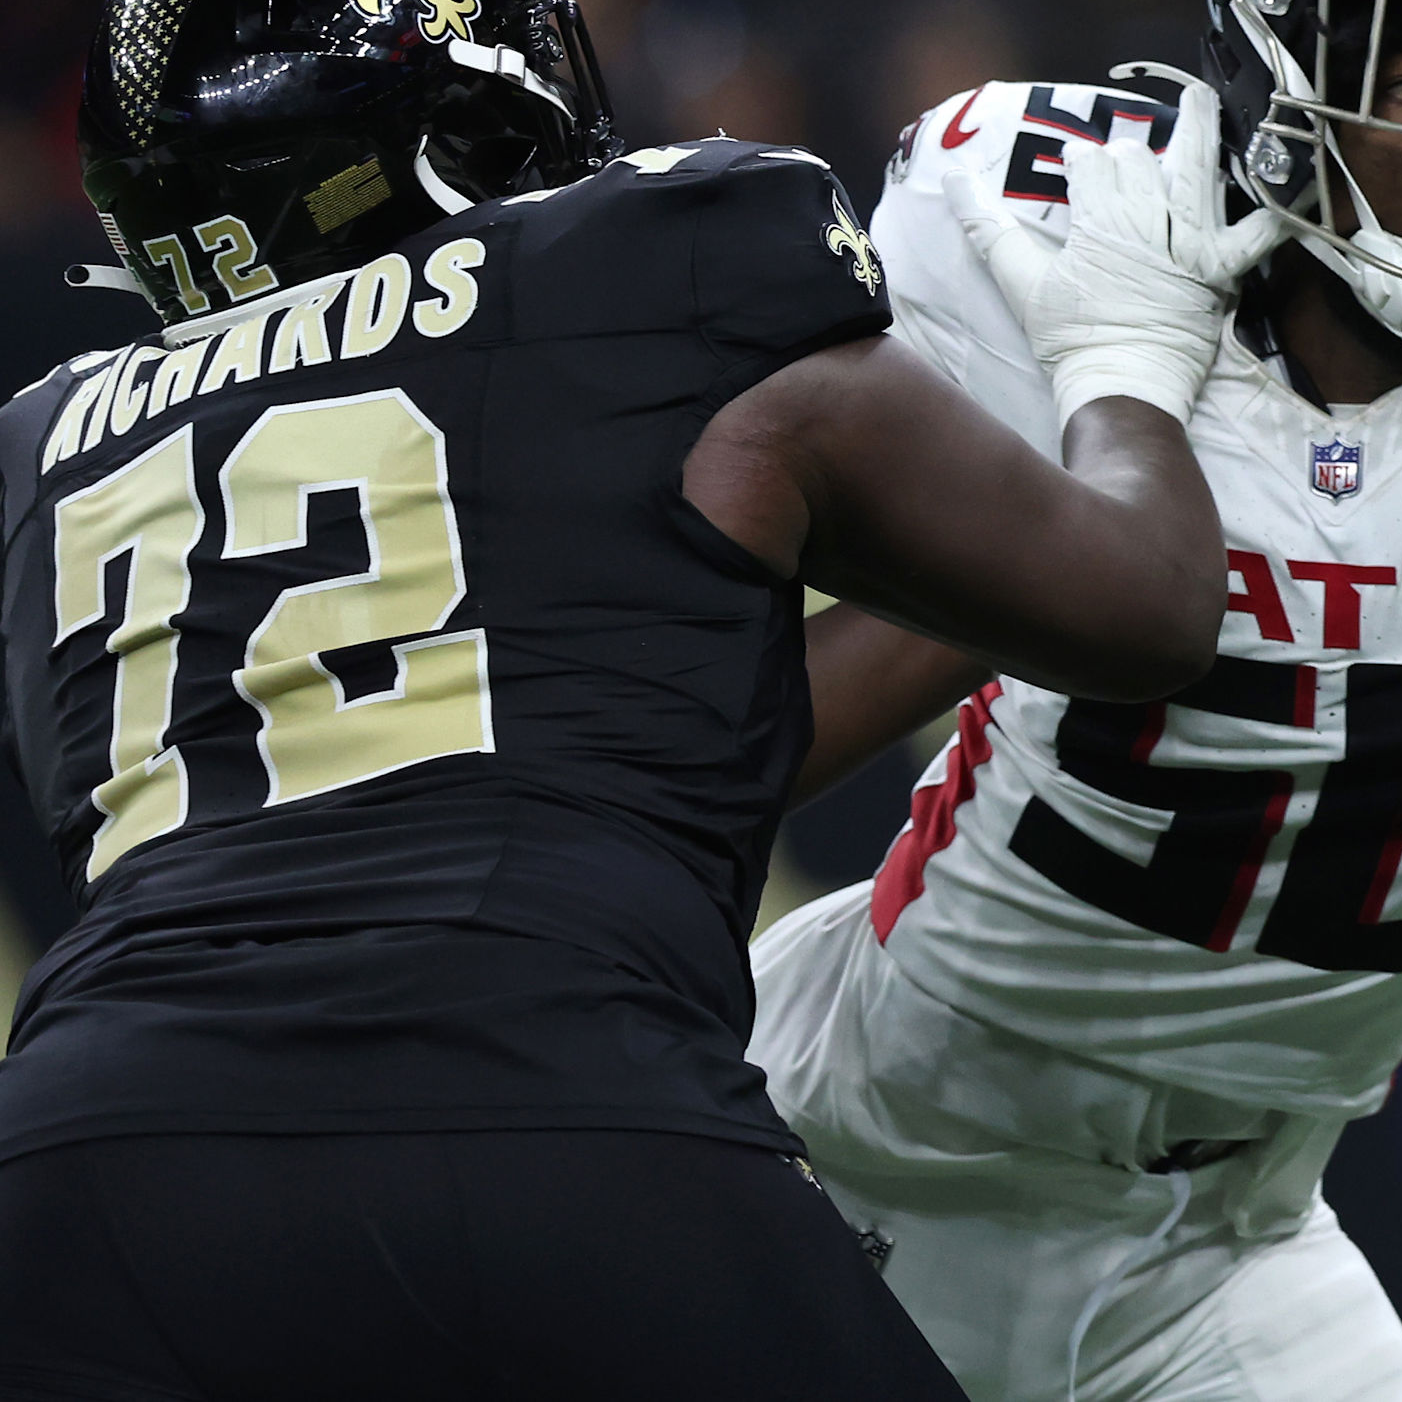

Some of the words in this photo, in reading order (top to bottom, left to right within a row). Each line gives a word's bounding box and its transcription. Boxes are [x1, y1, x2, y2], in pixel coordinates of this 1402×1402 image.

[143, 214, 280, 315] 72
[41, 237, 486, 476] RICHARDS
[1318, 464, 1355, 491] NFL
[53, 386, 496, 884] 72
